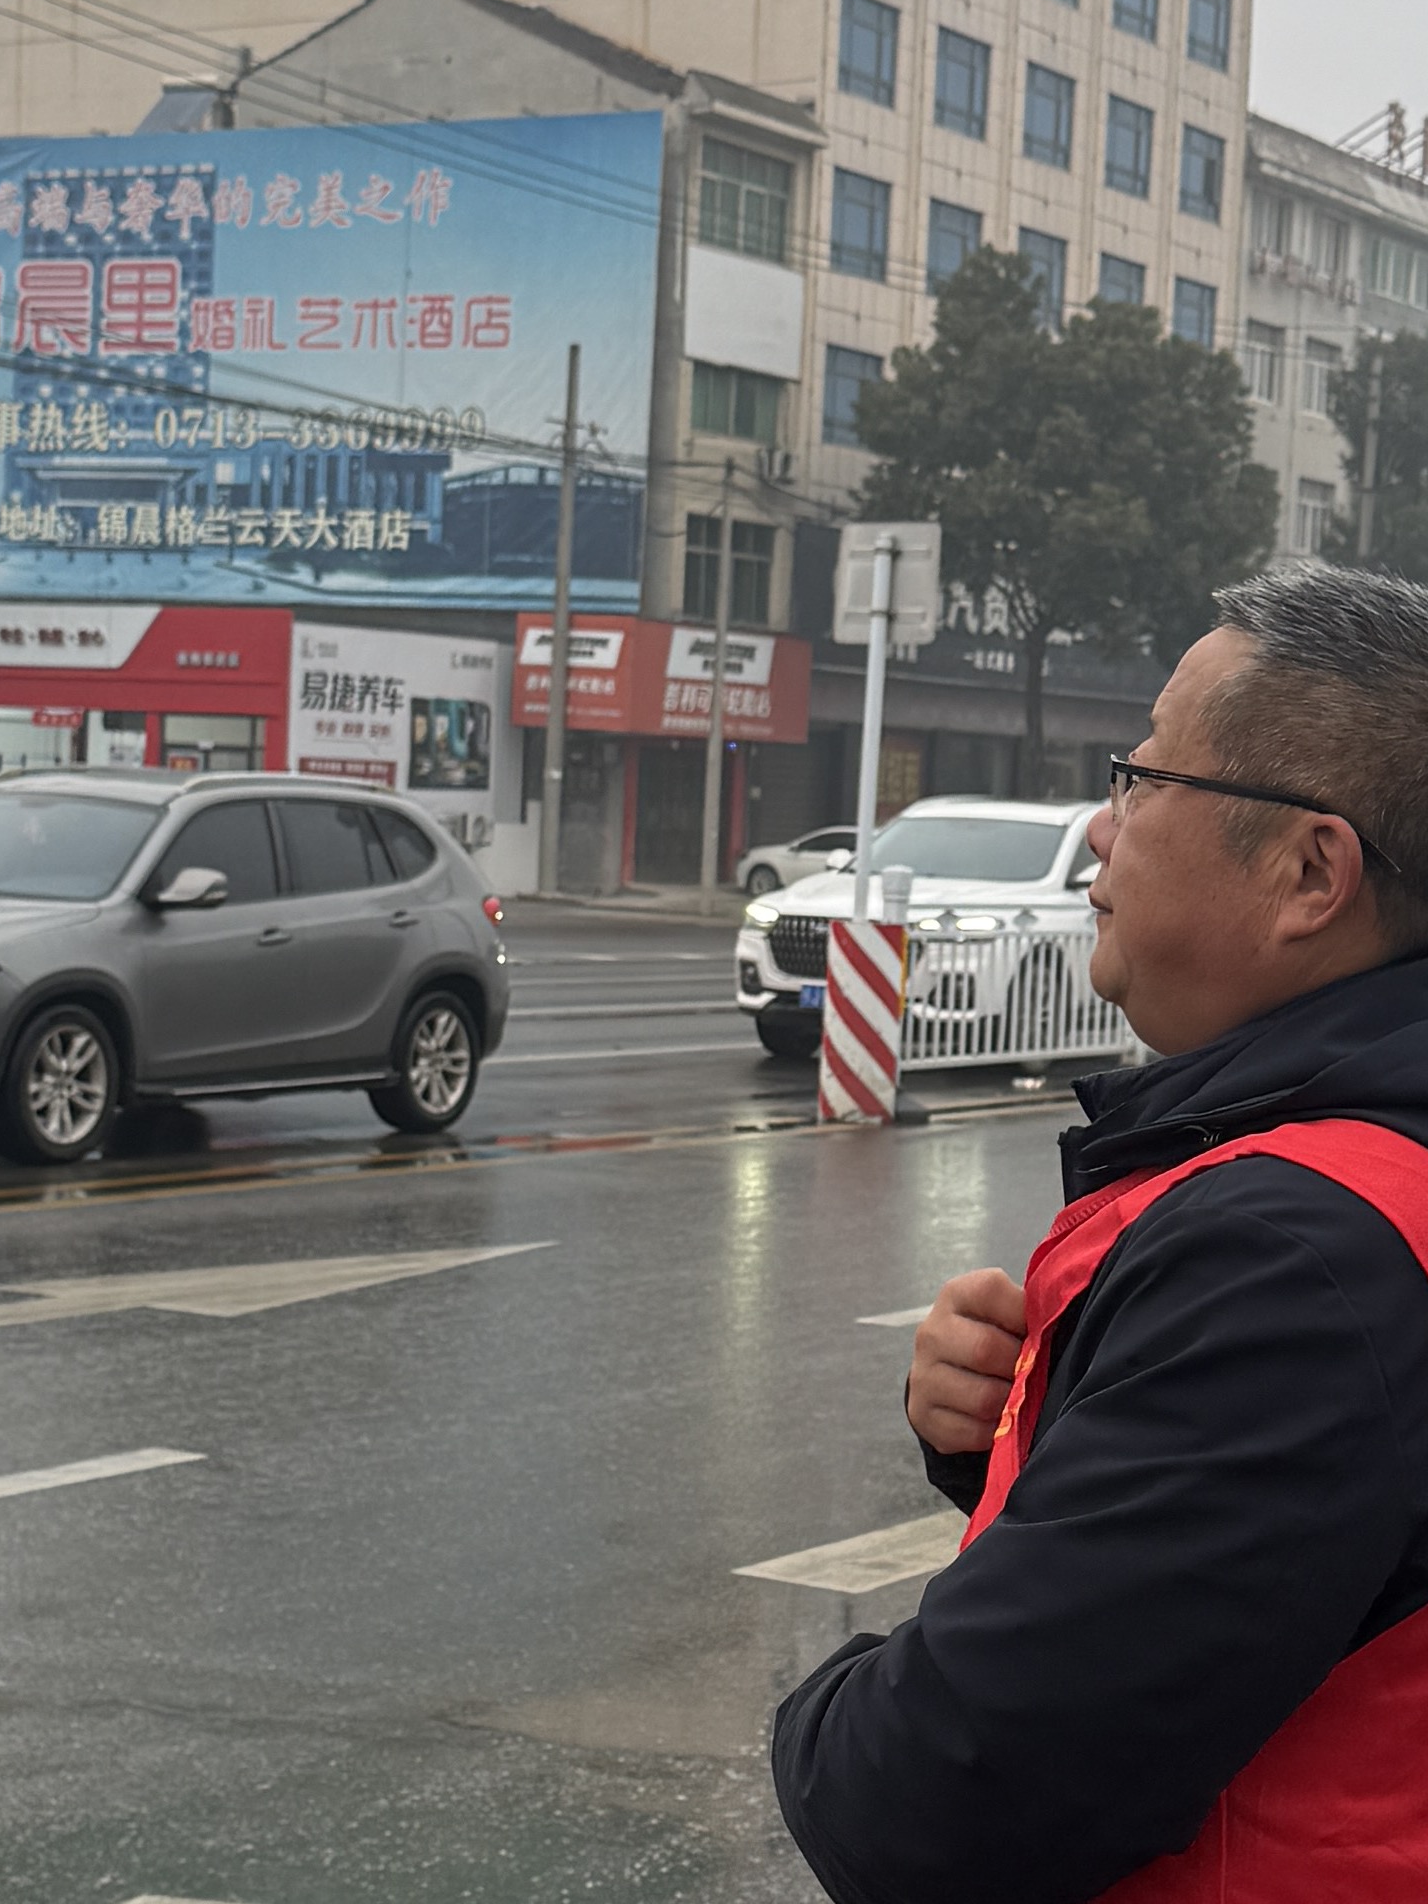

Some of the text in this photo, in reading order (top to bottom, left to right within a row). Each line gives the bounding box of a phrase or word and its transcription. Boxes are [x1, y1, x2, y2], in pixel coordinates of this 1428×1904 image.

[189, 294, 513, 353] 婚礼艺术酒店
[301, 670, 406, 716] 易捷养车
